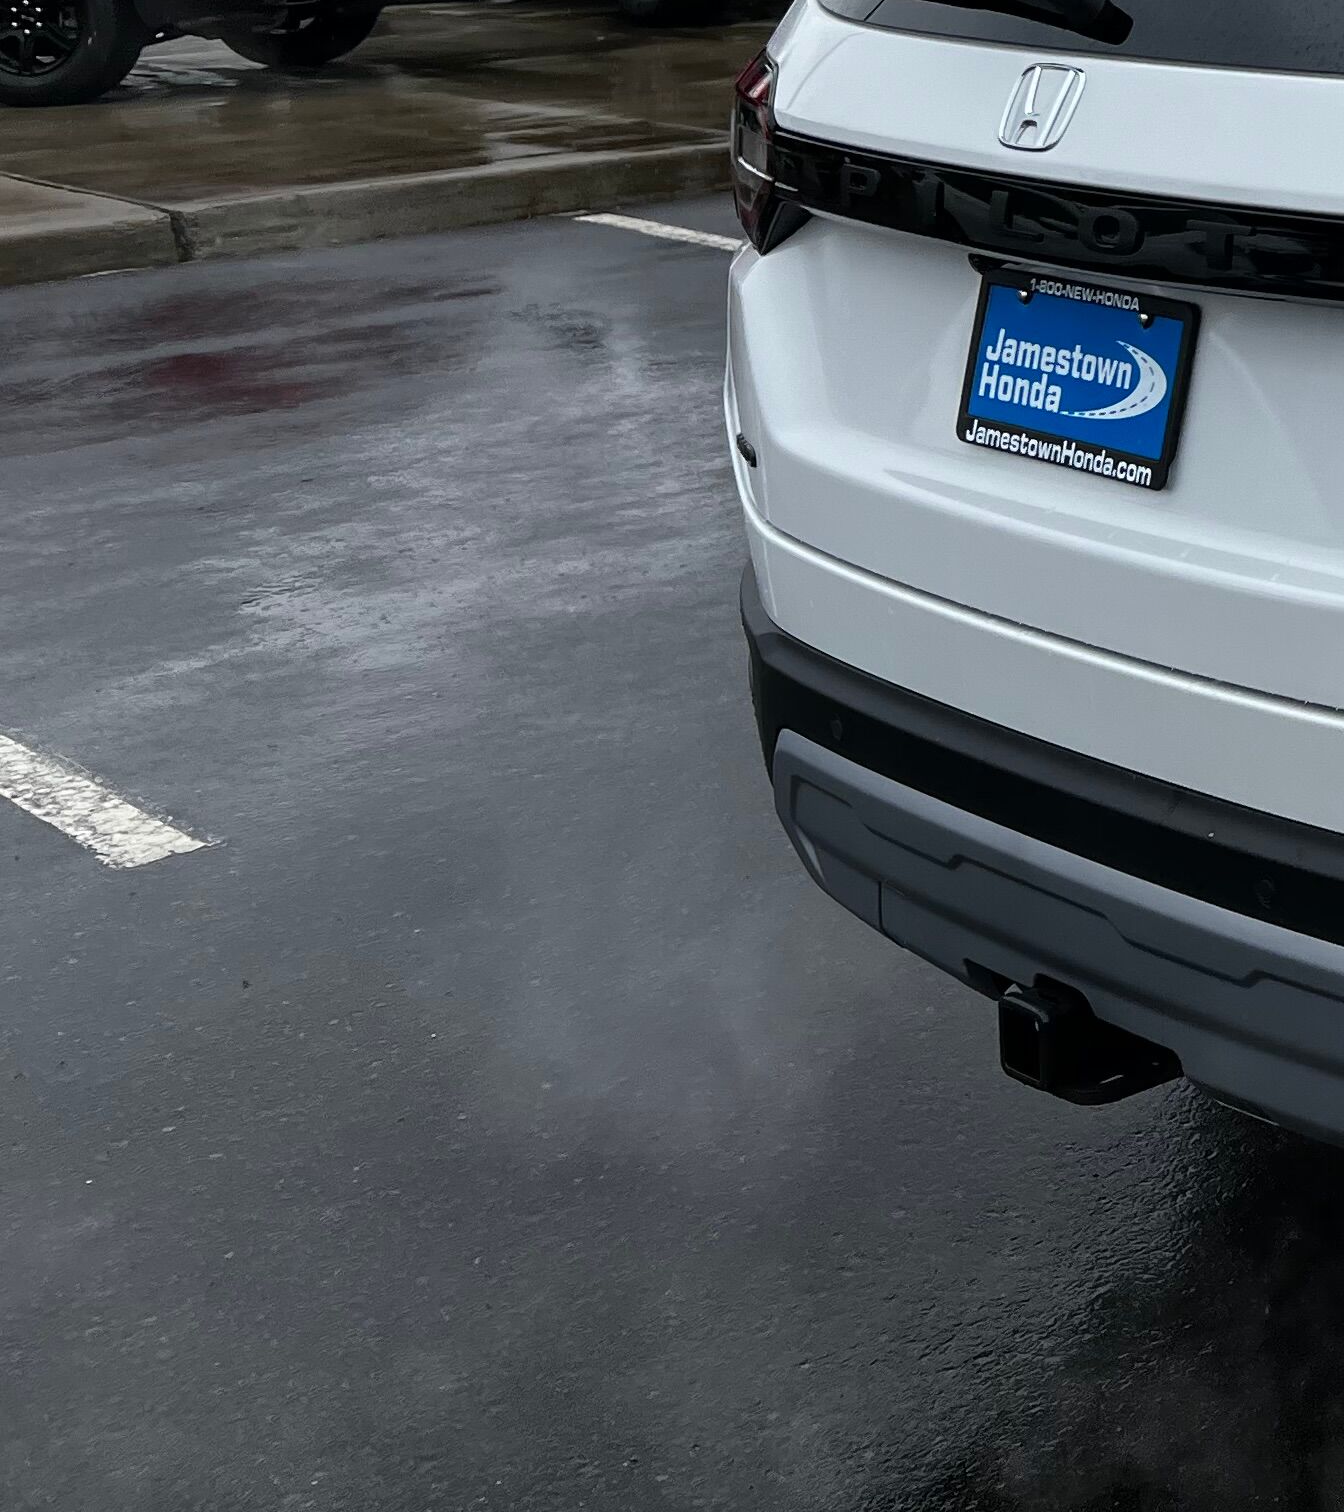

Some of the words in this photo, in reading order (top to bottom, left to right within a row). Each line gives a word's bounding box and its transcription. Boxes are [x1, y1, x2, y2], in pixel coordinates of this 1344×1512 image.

[842, 163, 1253, 271] PILOT
[1030, 278, 1140, 311] 1-800-NEW-HONDA
[978, 362, 1062, 413] Honda
[986, 328, 1133, 389] Jamestown
[965, 419, 1152, 486] JamestownHonda.com
